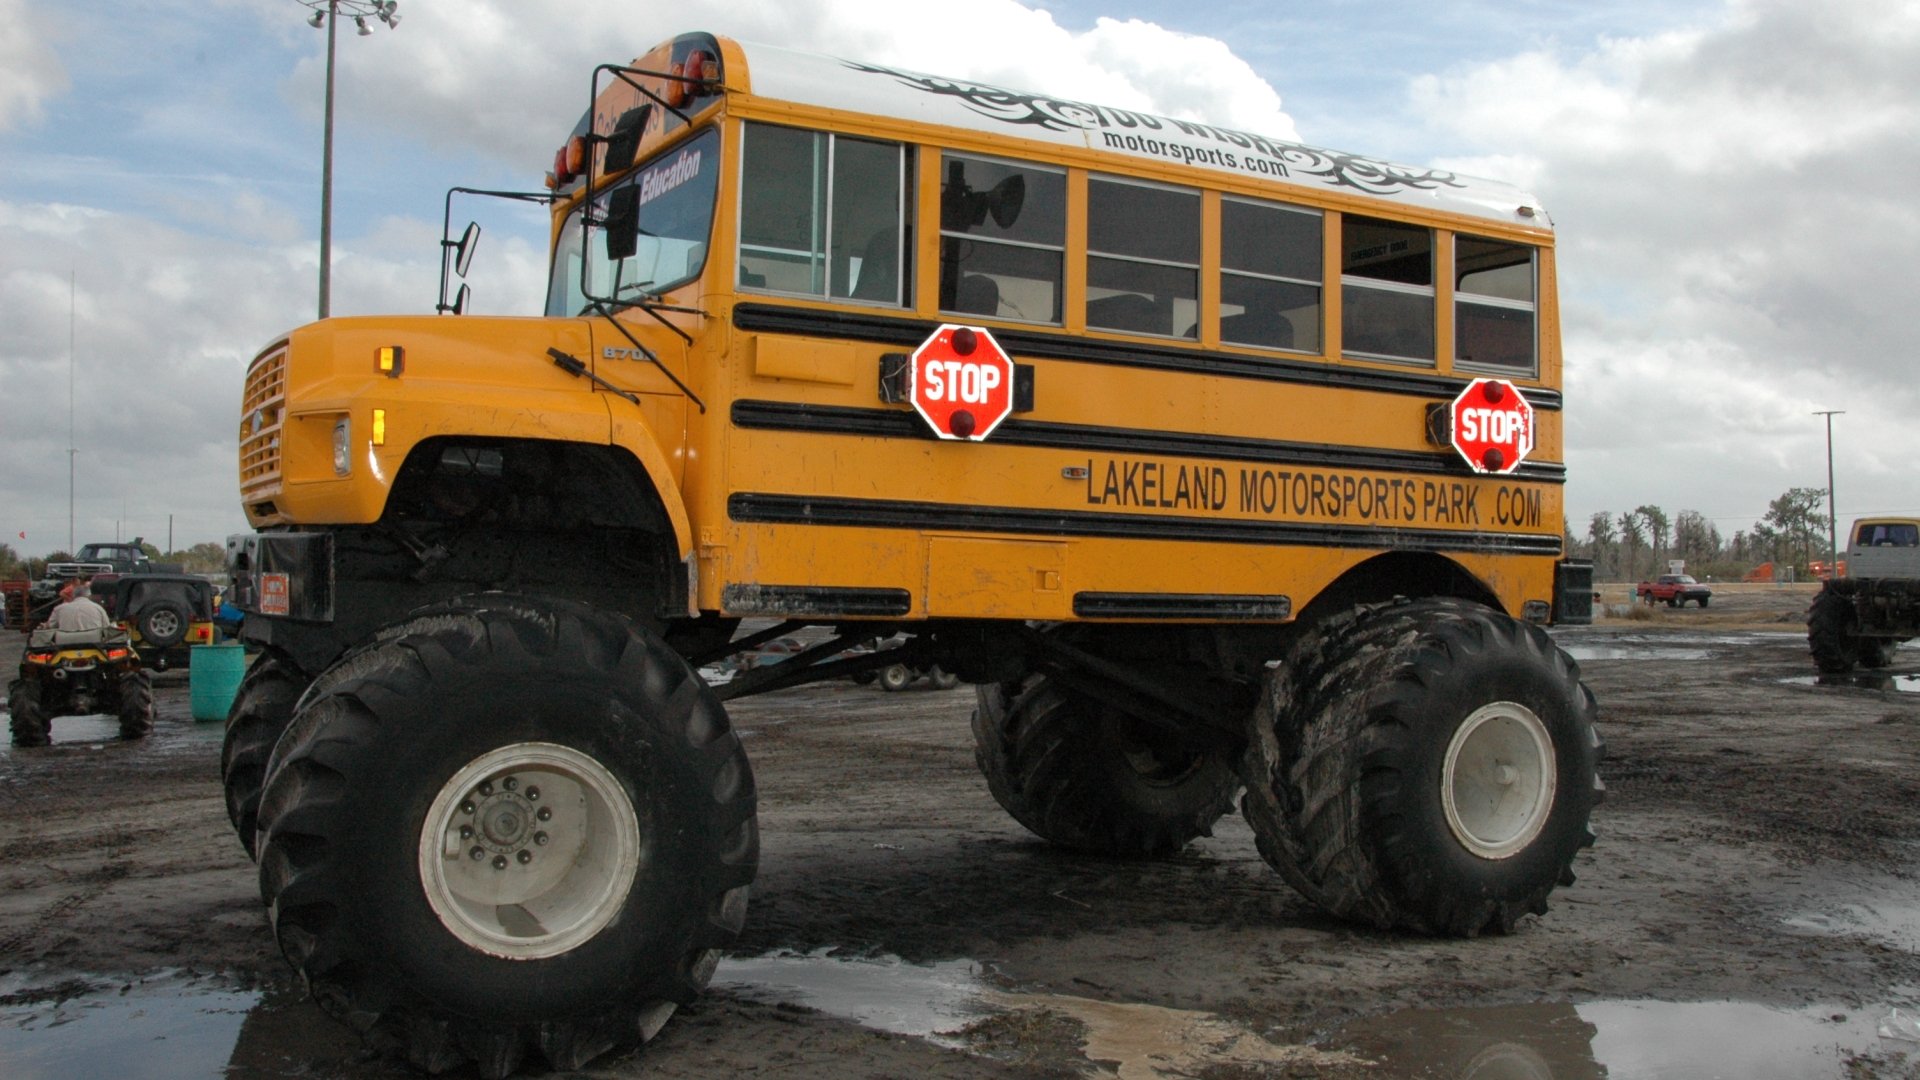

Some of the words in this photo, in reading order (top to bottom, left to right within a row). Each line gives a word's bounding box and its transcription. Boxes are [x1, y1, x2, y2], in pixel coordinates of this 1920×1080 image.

[1102, 131, 1290, 178] motorsports.com
[640, 151, 701, 206] Education
[925, 360, 1001, 404] STOP
[1461, 407, 1525, 444] STOP
[1087, 459, 1227, 511] LAKELAND
[1240, 479, 1416, 521] MOTORSPORTS
[1423, 481, 1480, 525] PARK
[1490, 486, 1541, 527] .COM
